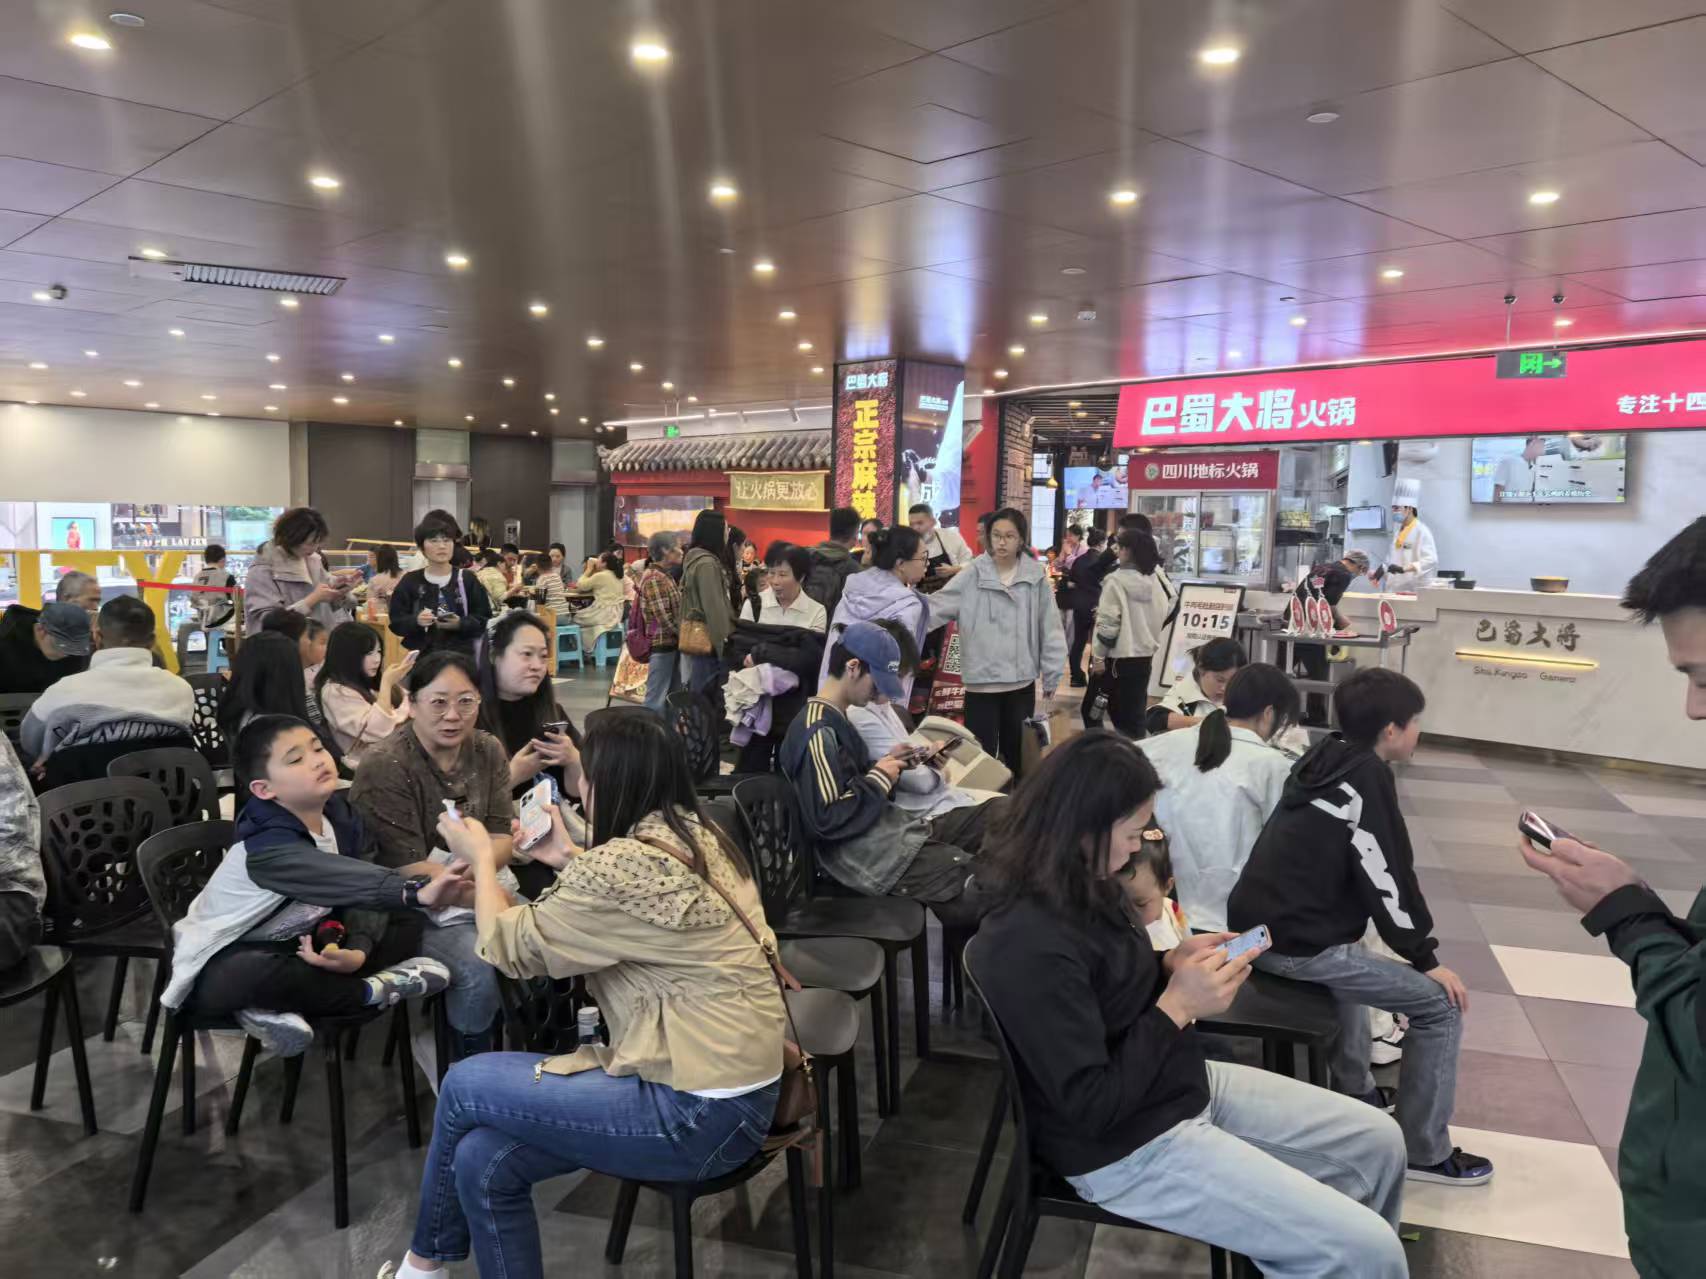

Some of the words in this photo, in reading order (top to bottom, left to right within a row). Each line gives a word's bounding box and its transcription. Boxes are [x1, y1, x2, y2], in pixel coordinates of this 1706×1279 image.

[845, 371, 889, 390] 巴蜀大将
[1141, 388, 1357, 436] 巴蜀大将火锅
[1616, 392, 1706, 415] 专注十四
[1162, 462, 1260, 479] 四川地标火锅
[735, 480, 819, 500] 让火锅更放心
[1183, 612, 1230, 629] 10:15
[1475, 618, 1581, 652] 巴蜀大将
